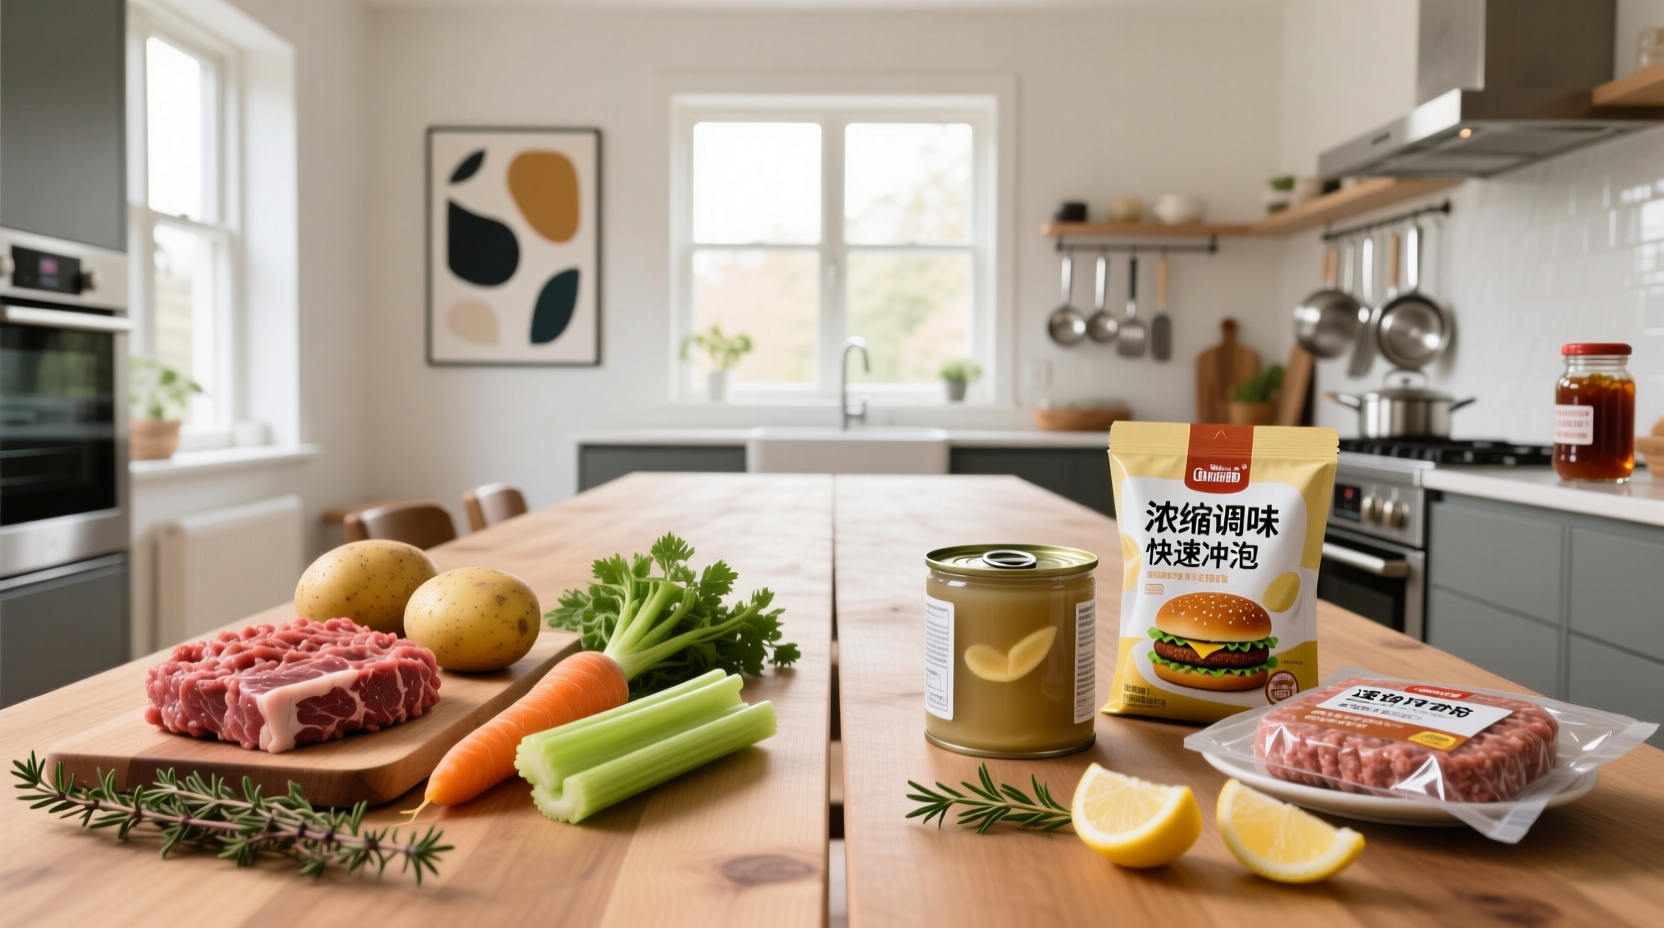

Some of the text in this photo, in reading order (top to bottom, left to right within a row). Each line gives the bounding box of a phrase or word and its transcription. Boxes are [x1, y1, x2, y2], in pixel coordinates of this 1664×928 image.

[1145, 500, 1279, 538] 浓缩调味
[1145, 538, 1259, 569] 快速冲泡
